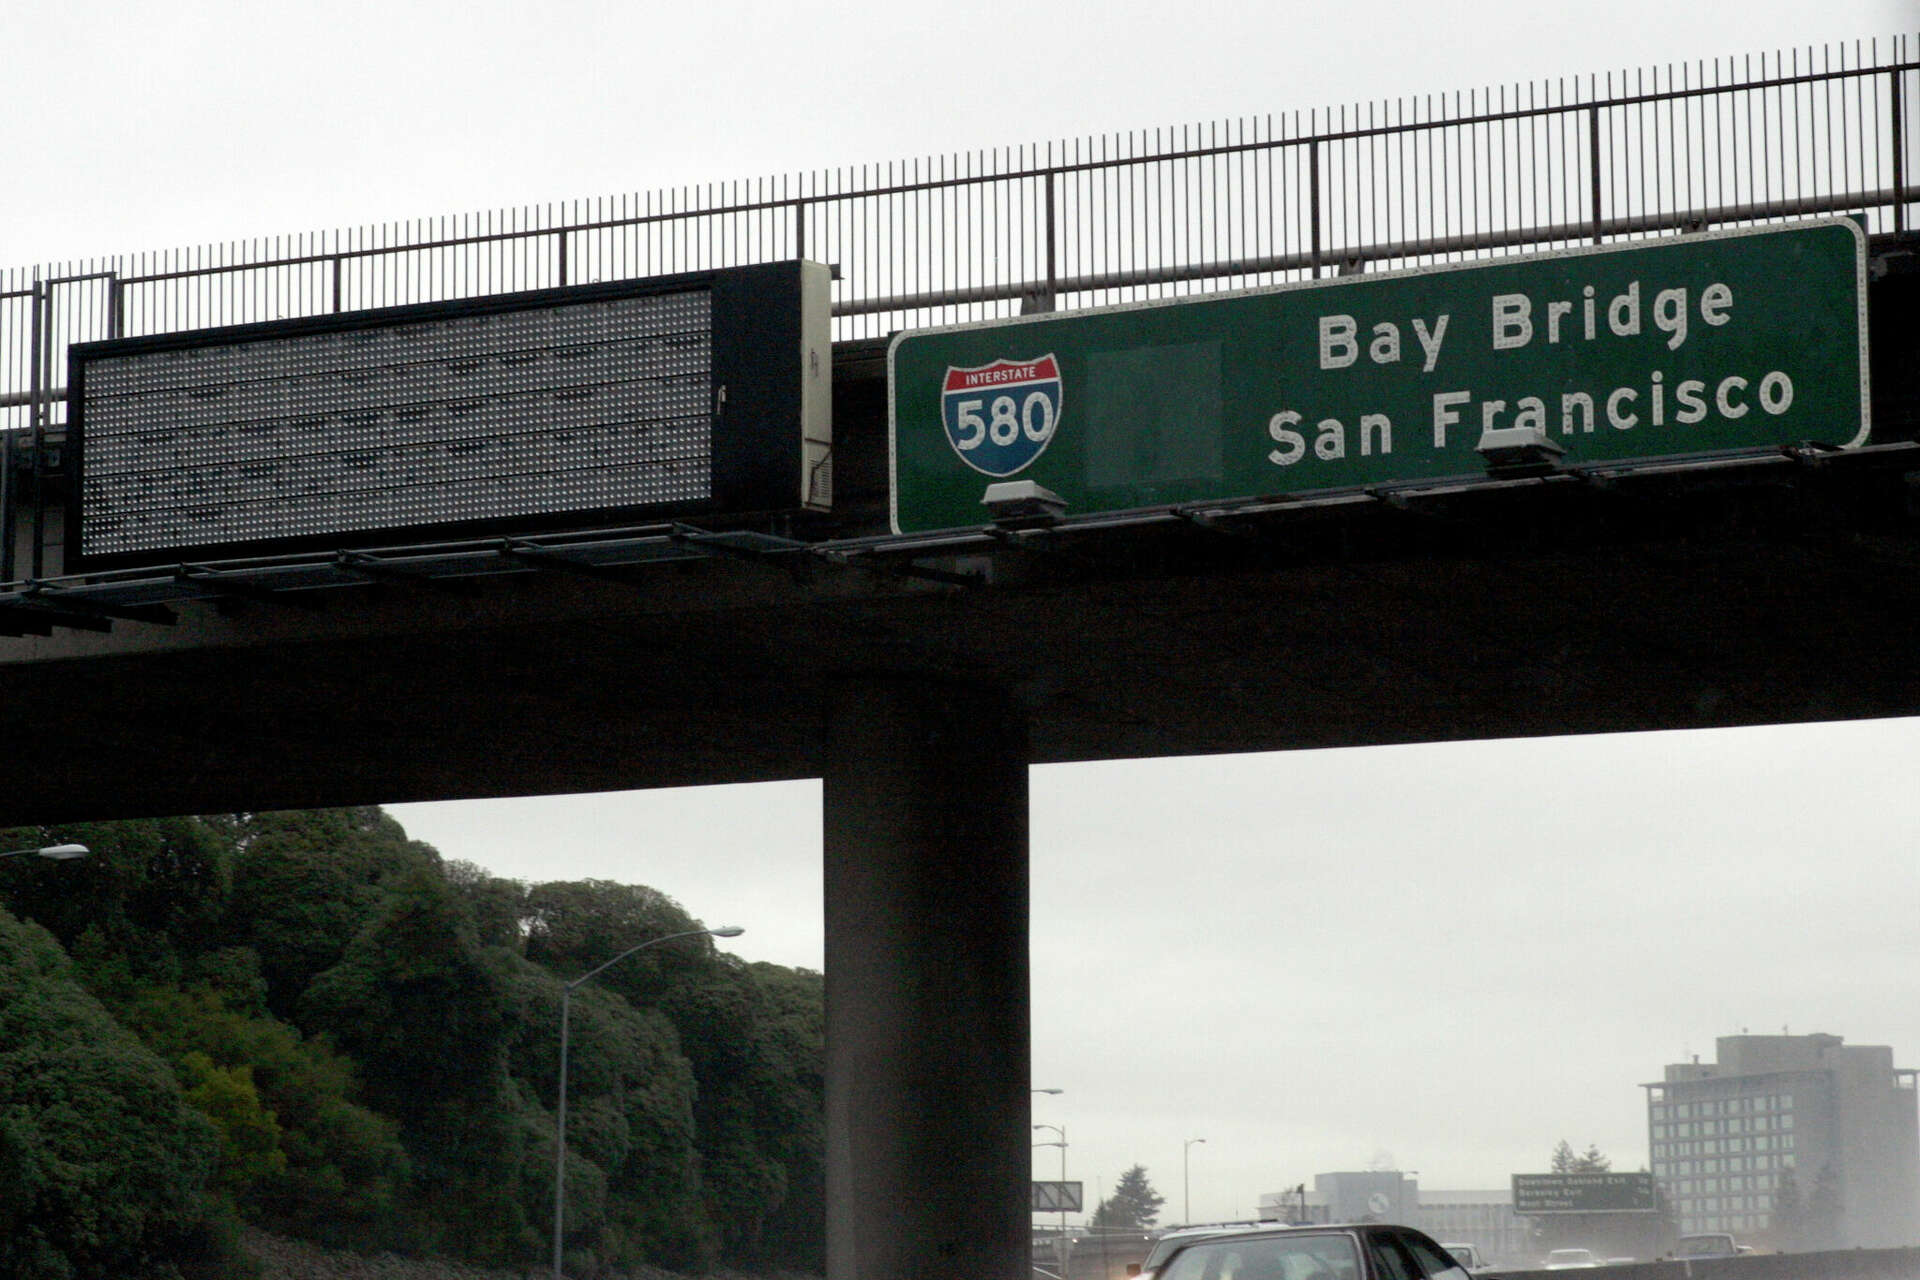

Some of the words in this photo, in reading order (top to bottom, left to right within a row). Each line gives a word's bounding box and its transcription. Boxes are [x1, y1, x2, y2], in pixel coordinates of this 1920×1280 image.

[1319, 314, 1449, 372] Bay
[1492, 280, 1733, 351] Bridge
[966, 366, 1036, 385] INTERSTATE
[957, 391, 1053, 450] 580
[1268, 410, 1392, 465] San
[1433, 370, 1793, 448] Francisco
